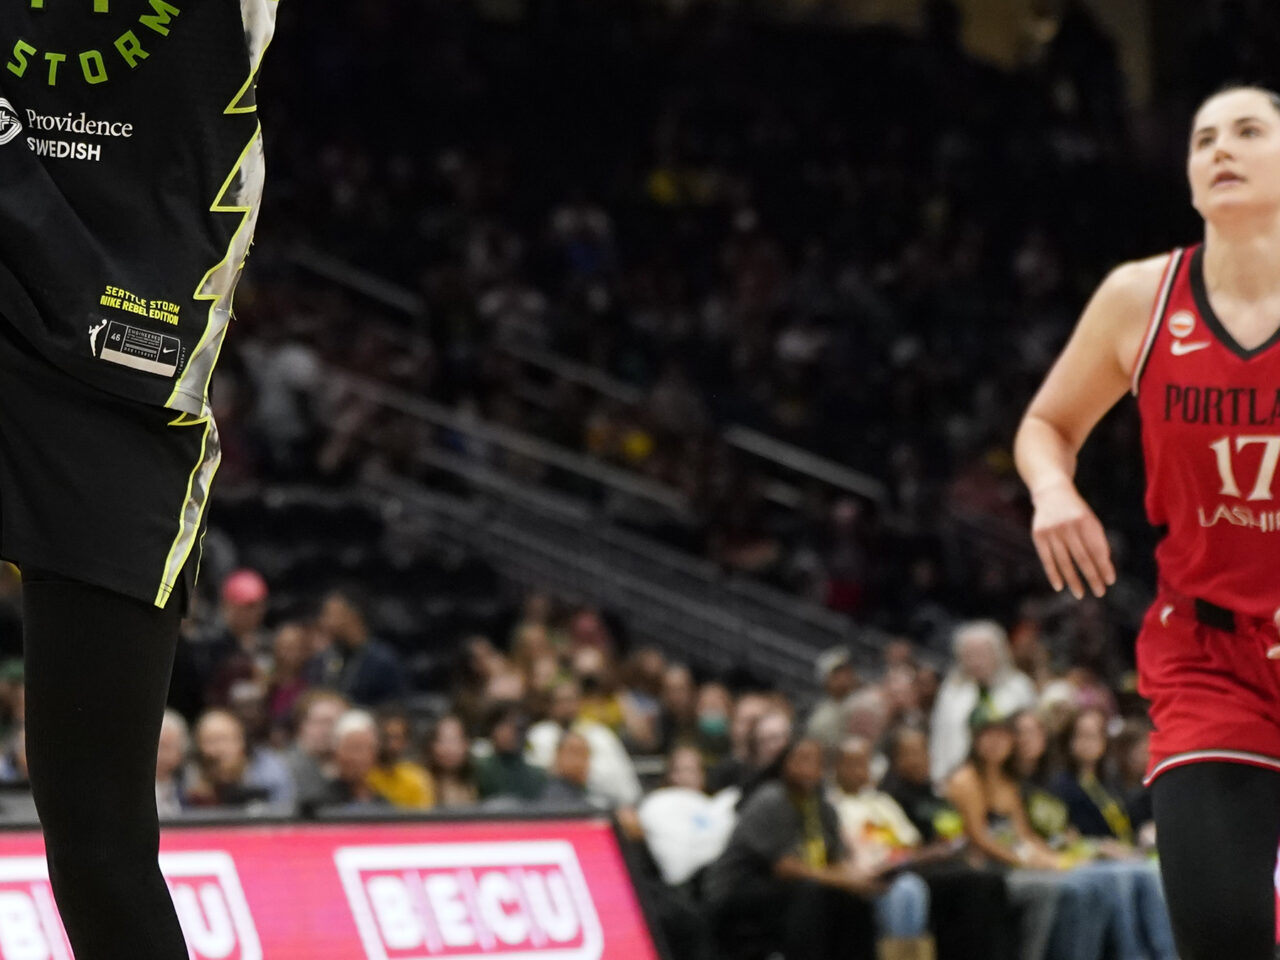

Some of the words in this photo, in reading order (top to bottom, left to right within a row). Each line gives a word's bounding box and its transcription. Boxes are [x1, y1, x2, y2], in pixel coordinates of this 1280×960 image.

[25, 108, 134, 138] Providence
[26, 137, 102, 161] SWEDISH
[100, 295, 122, 309] NIKE
[122, 300, 148, 317] REBEL
[149, 309, 180, 326] EDITION
[105, 285, 147, 307] SEATTLE
[149, 300, 180, 315] STORM
[1209, 434, 1280, 502] 17
[366, 868, 580, 950] BECU
